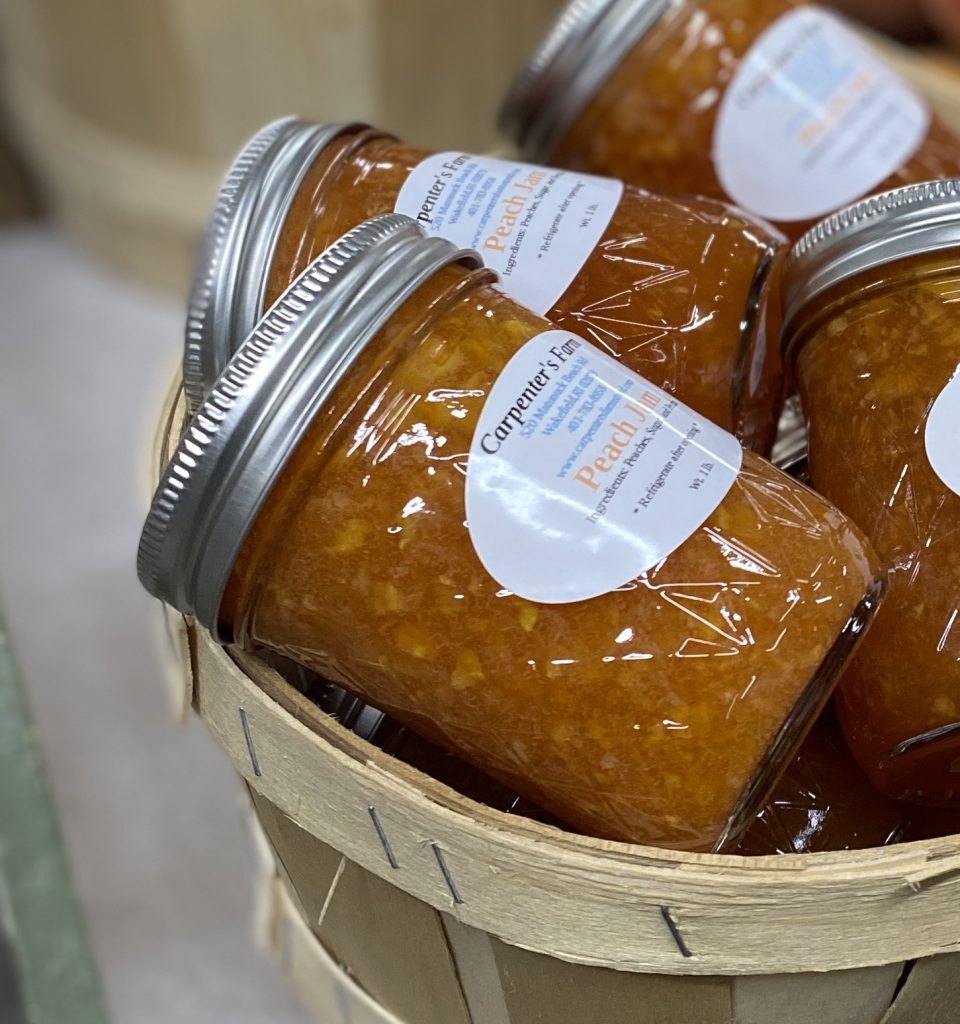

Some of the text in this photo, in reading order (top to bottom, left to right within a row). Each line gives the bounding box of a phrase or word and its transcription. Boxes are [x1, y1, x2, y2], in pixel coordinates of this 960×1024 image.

[483, 170, 546, 253] Peach Jam
[541, 213, 563, 252] Refrigerate
[480, 338, 582, 455] Carpenter's Farm
[520, 419, 538, 438] 520
[573, 420, 639, 491] Peach
[638, 461, 674, 508] Refrigerate
